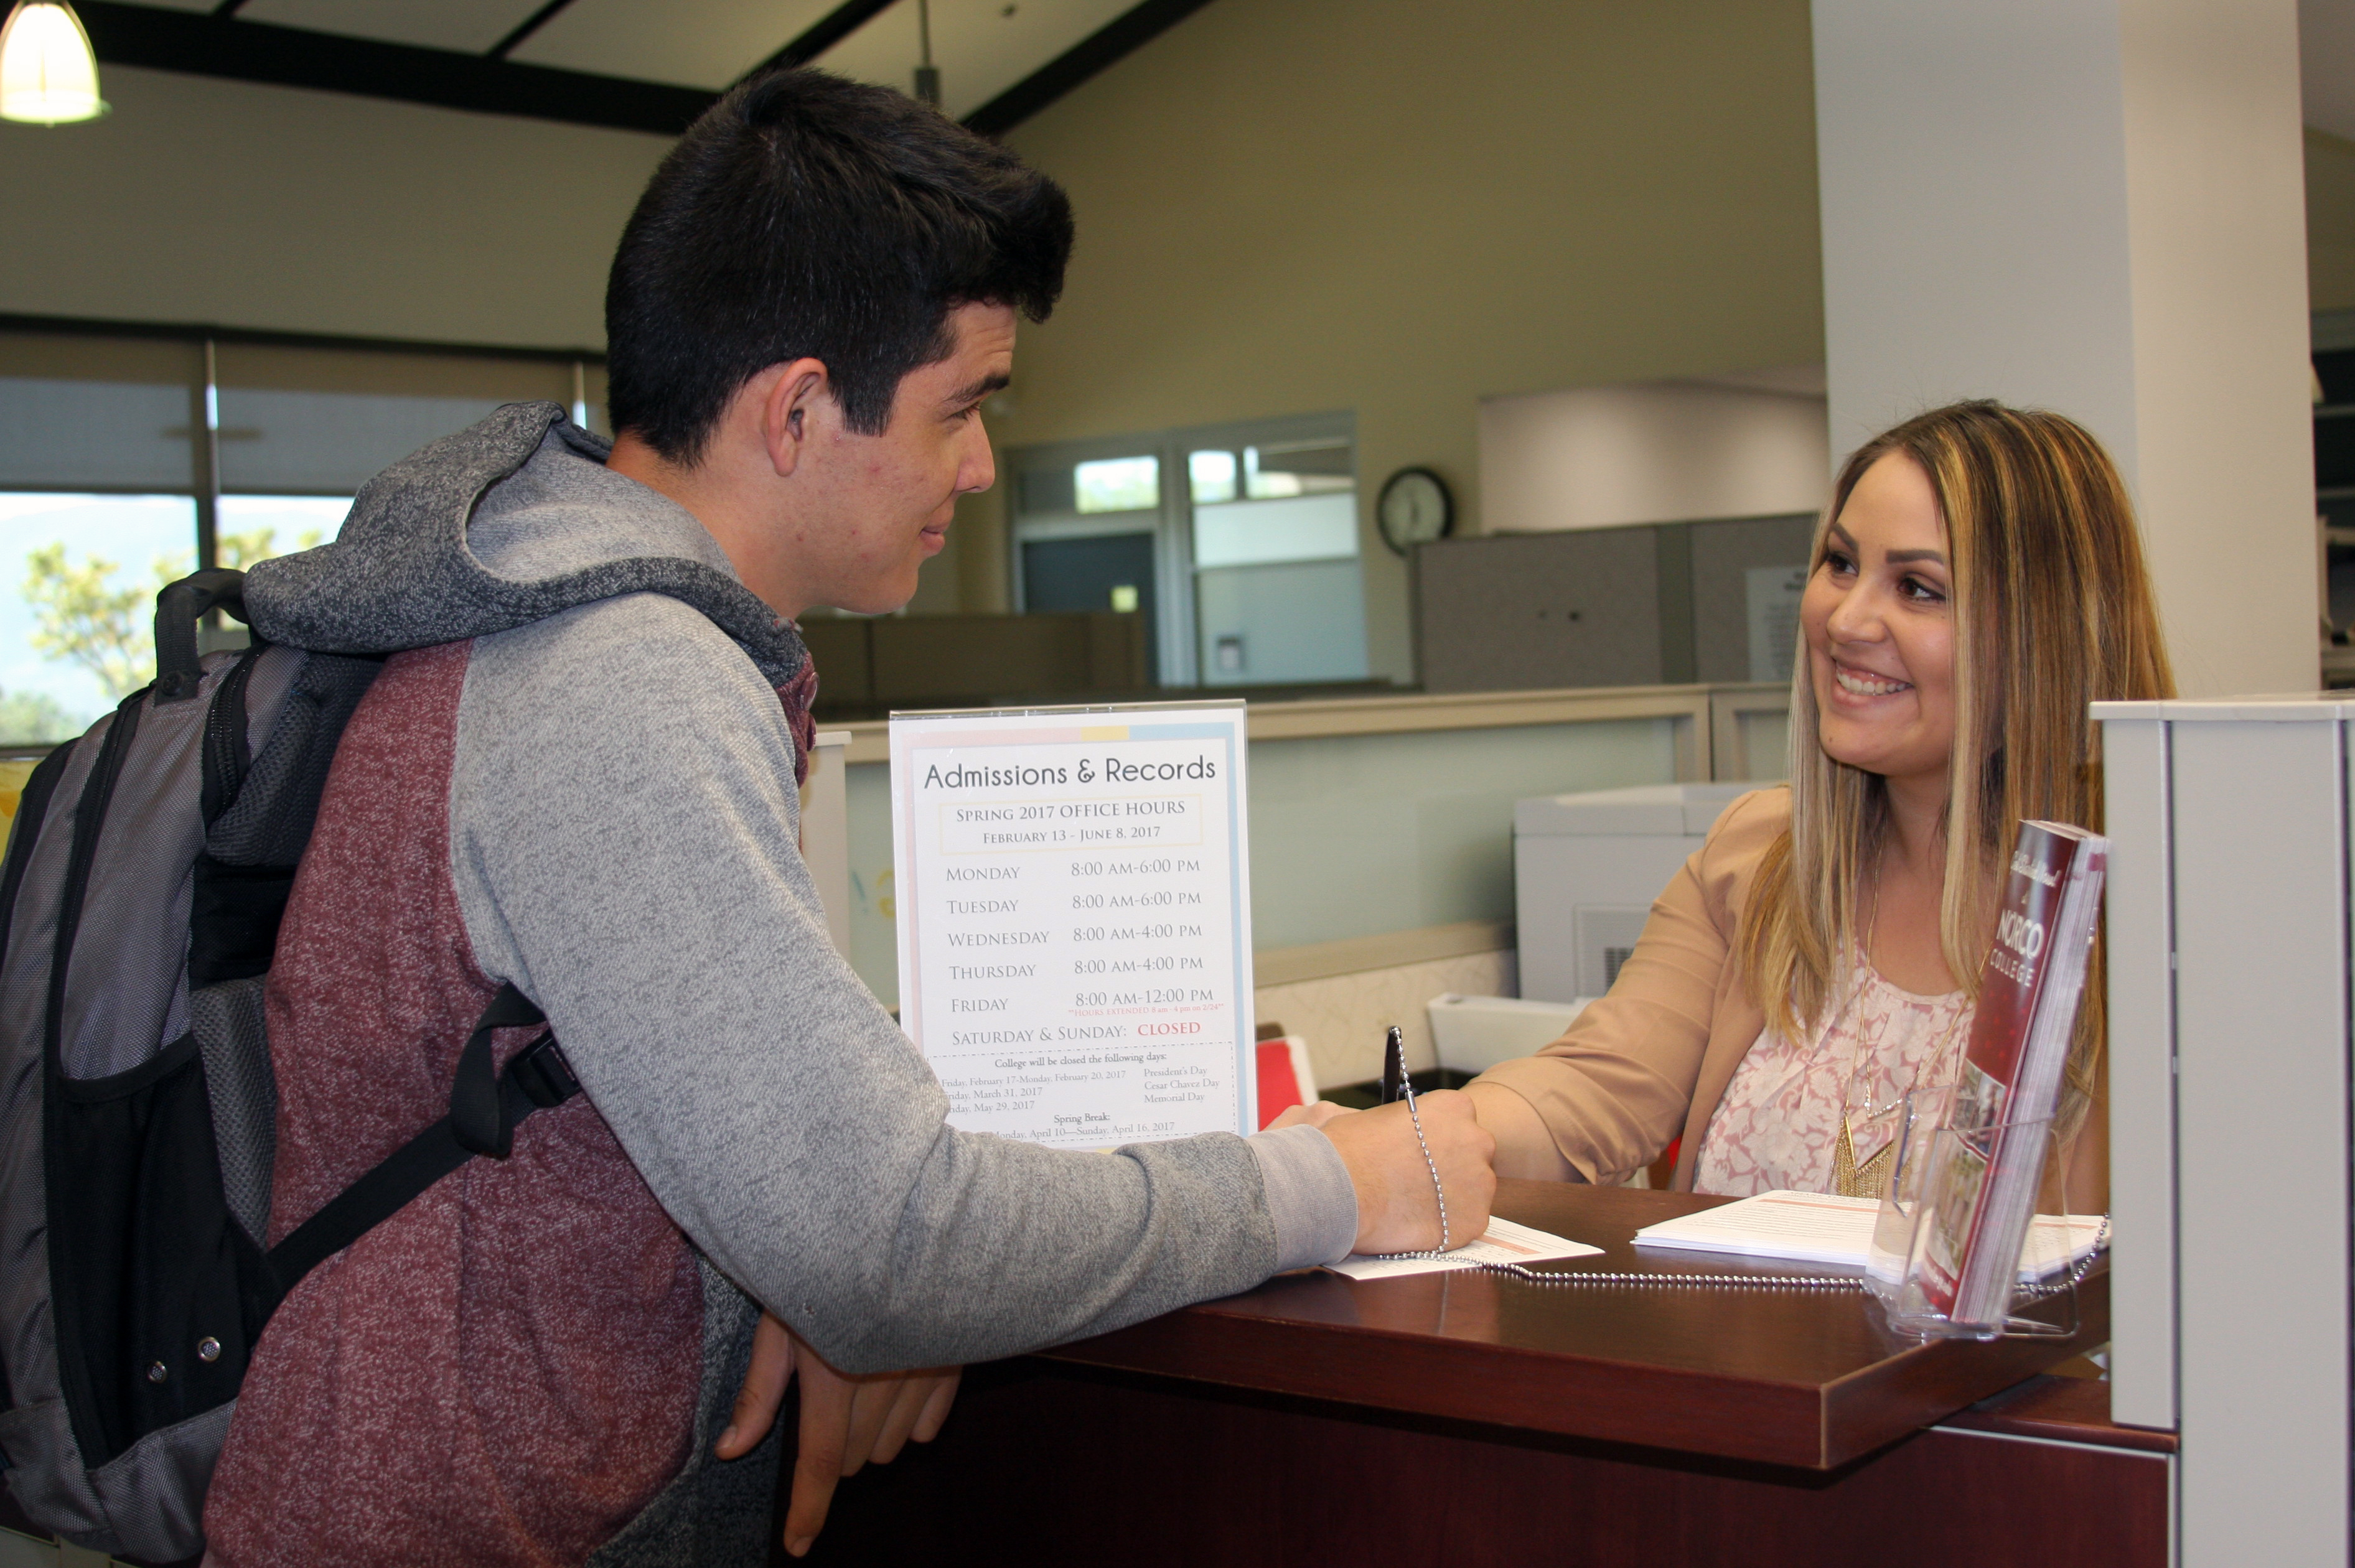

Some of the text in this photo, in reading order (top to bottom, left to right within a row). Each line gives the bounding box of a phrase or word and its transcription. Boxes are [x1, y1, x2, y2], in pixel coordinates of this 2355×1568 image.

[924, 755, 1215, 788] Admissions & Records
[957, 801, 1184, 821] SPRING 2017 OFFICE HOURS
[984, 832, 1047, 844] FEBRUARY
[1052, 830, 1065, 841] 13
[1080, 829, 1112, 842] JUNE
[1117, 828, 1126, 838] 8,
[1131, 826, 1160, 838] 2017
[947, 859, 1199, 881] MONDAY 8:00 AM-6:00 PM
[947, 892, 1201, 913] TUESDAY 8:00 AM-6:00 PM
[948, 924, 1202, 946] WEDNESDAY 8:00 AM-4:00 PM
[1997, 909, 2044, 959] NORCO
[949, 956, 1203, 979] THURSDAY 8:00 AM-4:00 PM
[1990, 948, 2034, 987] COLLEGE
[952, 989, 1213, 1012] FRIDAY 8:00 AM-12:00 PM
[953, 1022, 1201, 1045] SATURDAY & SUNDAY: CLOSED
[995, 1058, 1026, 1070] College
[1029, 1057, 1045, 1066] will
[1047, 1057, 1057, 1065] be
[1060, 1055, 1086, 1065] closed
[1089, 1054, 1102, 1063] the
[1105, 1053, 1144, 1063] following
[1144, 1066, 1207, 1076] President's Day
[970, 1077, 1003, 1086] February
[1055, 1073, 1089, 1082] February
[1106, 1070, 1126, 1079] 2017
[1145, 1078, 1220, 1090] Cesar Chavez Day
[946, 1091, 971, 1102] riday,
[974, 1089, 1001, 1098] March
[1020, 1087, 1042, 1097] 2017
[1145, 1092, 1204, 1103] Memorial Day
[950, 1104, 971, 1115] riday,
[974, 1103, 993, 1114] May
[1013, 1101, 1034, 1110] 2017
[1054, 1114, 1082, 1126] Spring
[997, 1130, 1027, 1141] onday,
[1030, 1129, 1051, 1139] April
[1113, 1124, 1134, 1134] April
[1153, 1122, 1174, 1131] 2017
